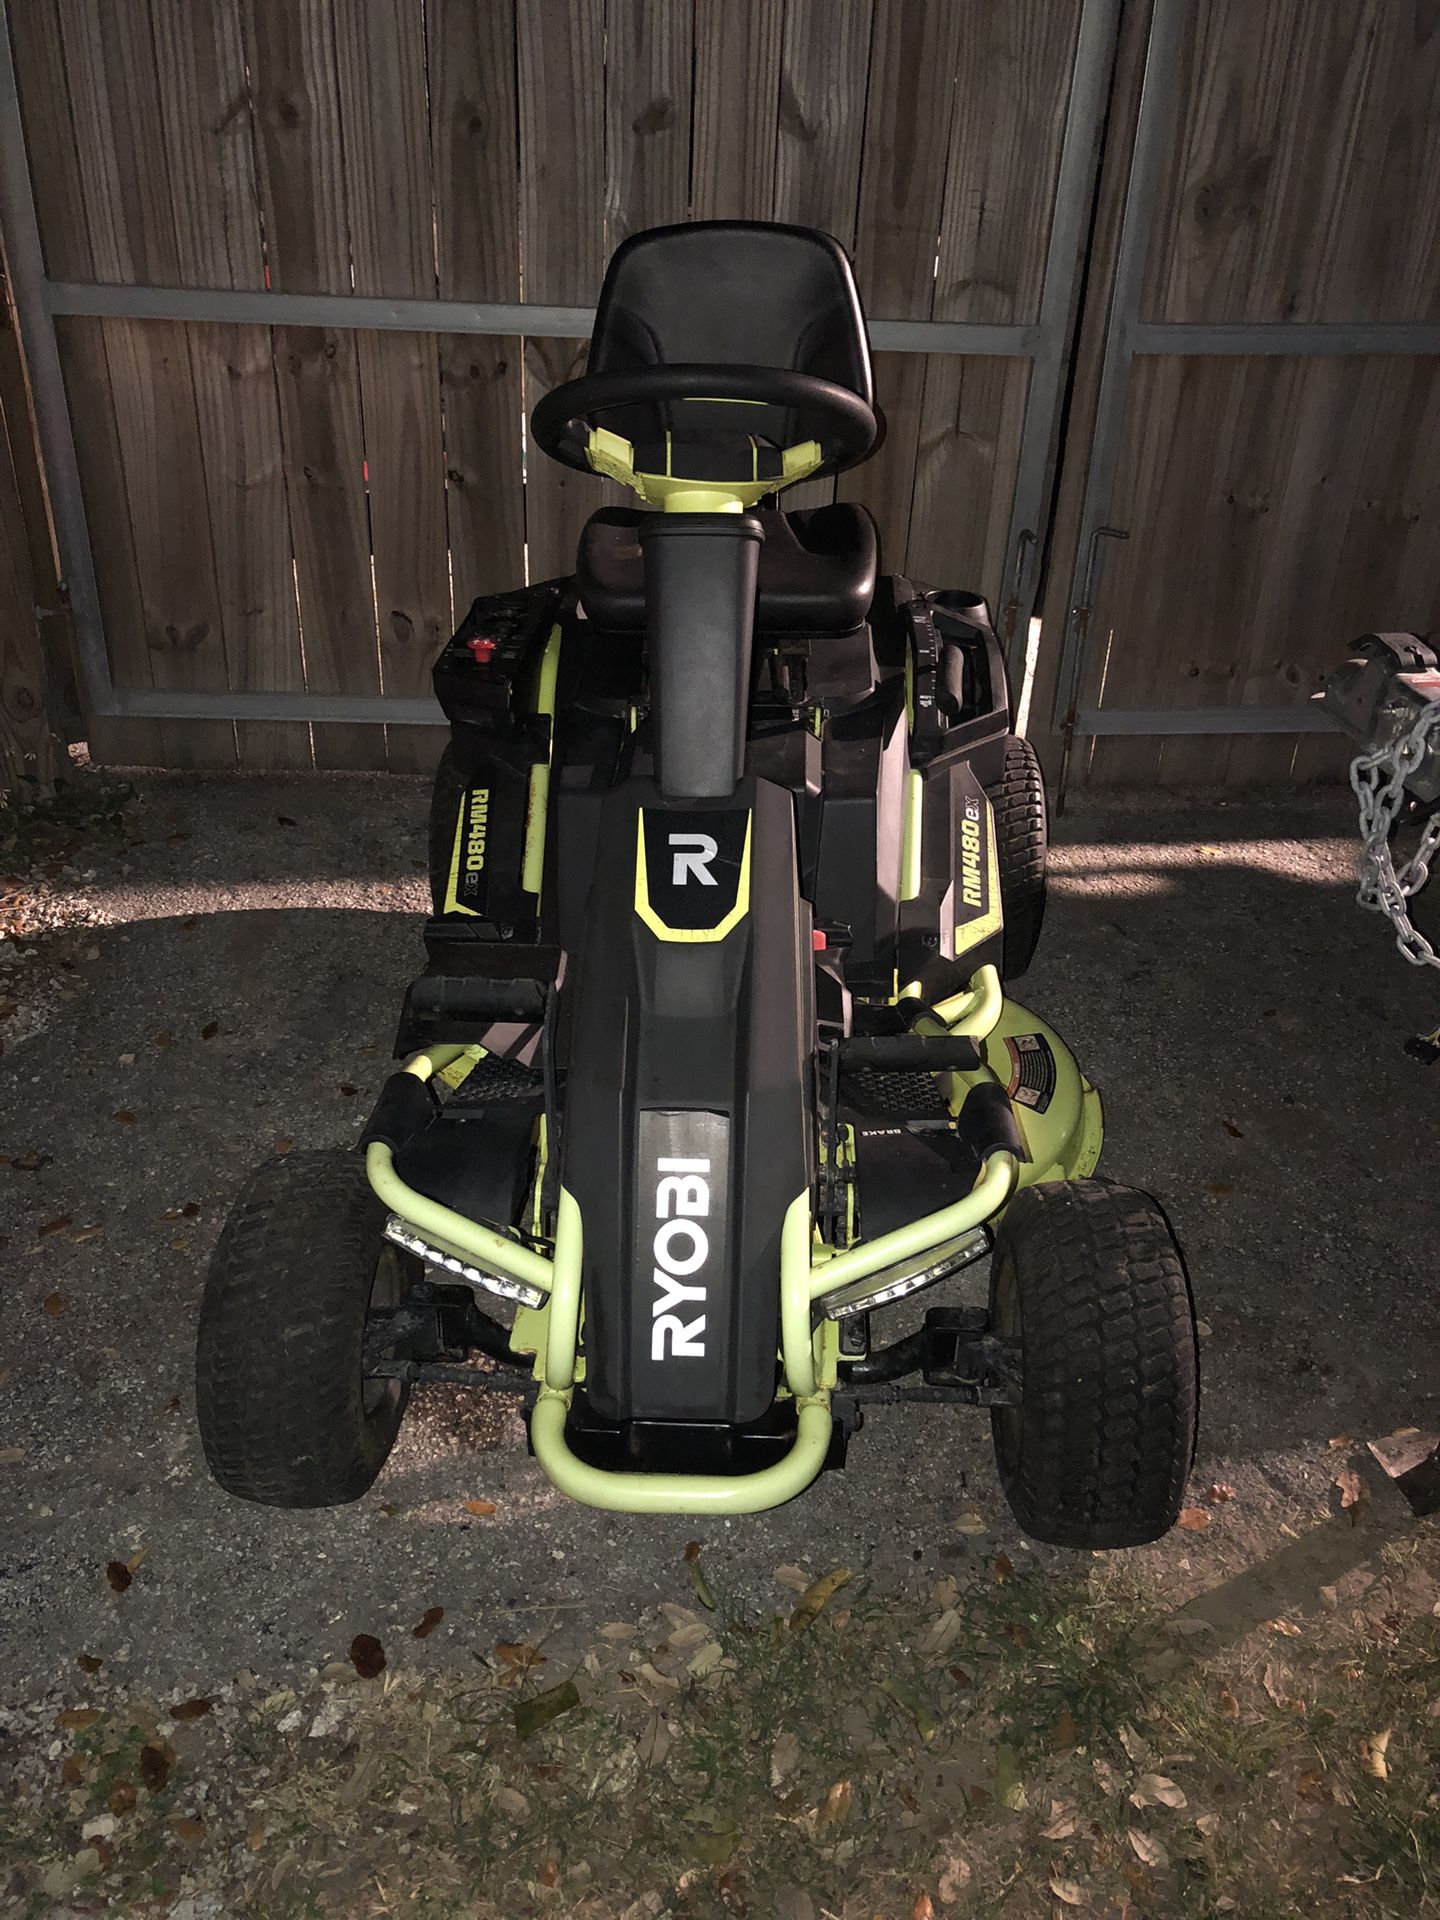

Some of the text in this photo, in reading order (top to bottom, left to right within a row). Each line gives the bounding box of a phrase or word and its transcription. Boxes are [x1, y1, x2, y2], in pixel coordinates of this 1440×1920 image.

[668, 833, 719, 886] R
[861, 1128, 902, 1137] BRAKE
[651, 1157, 710, 1361] RYOBI
